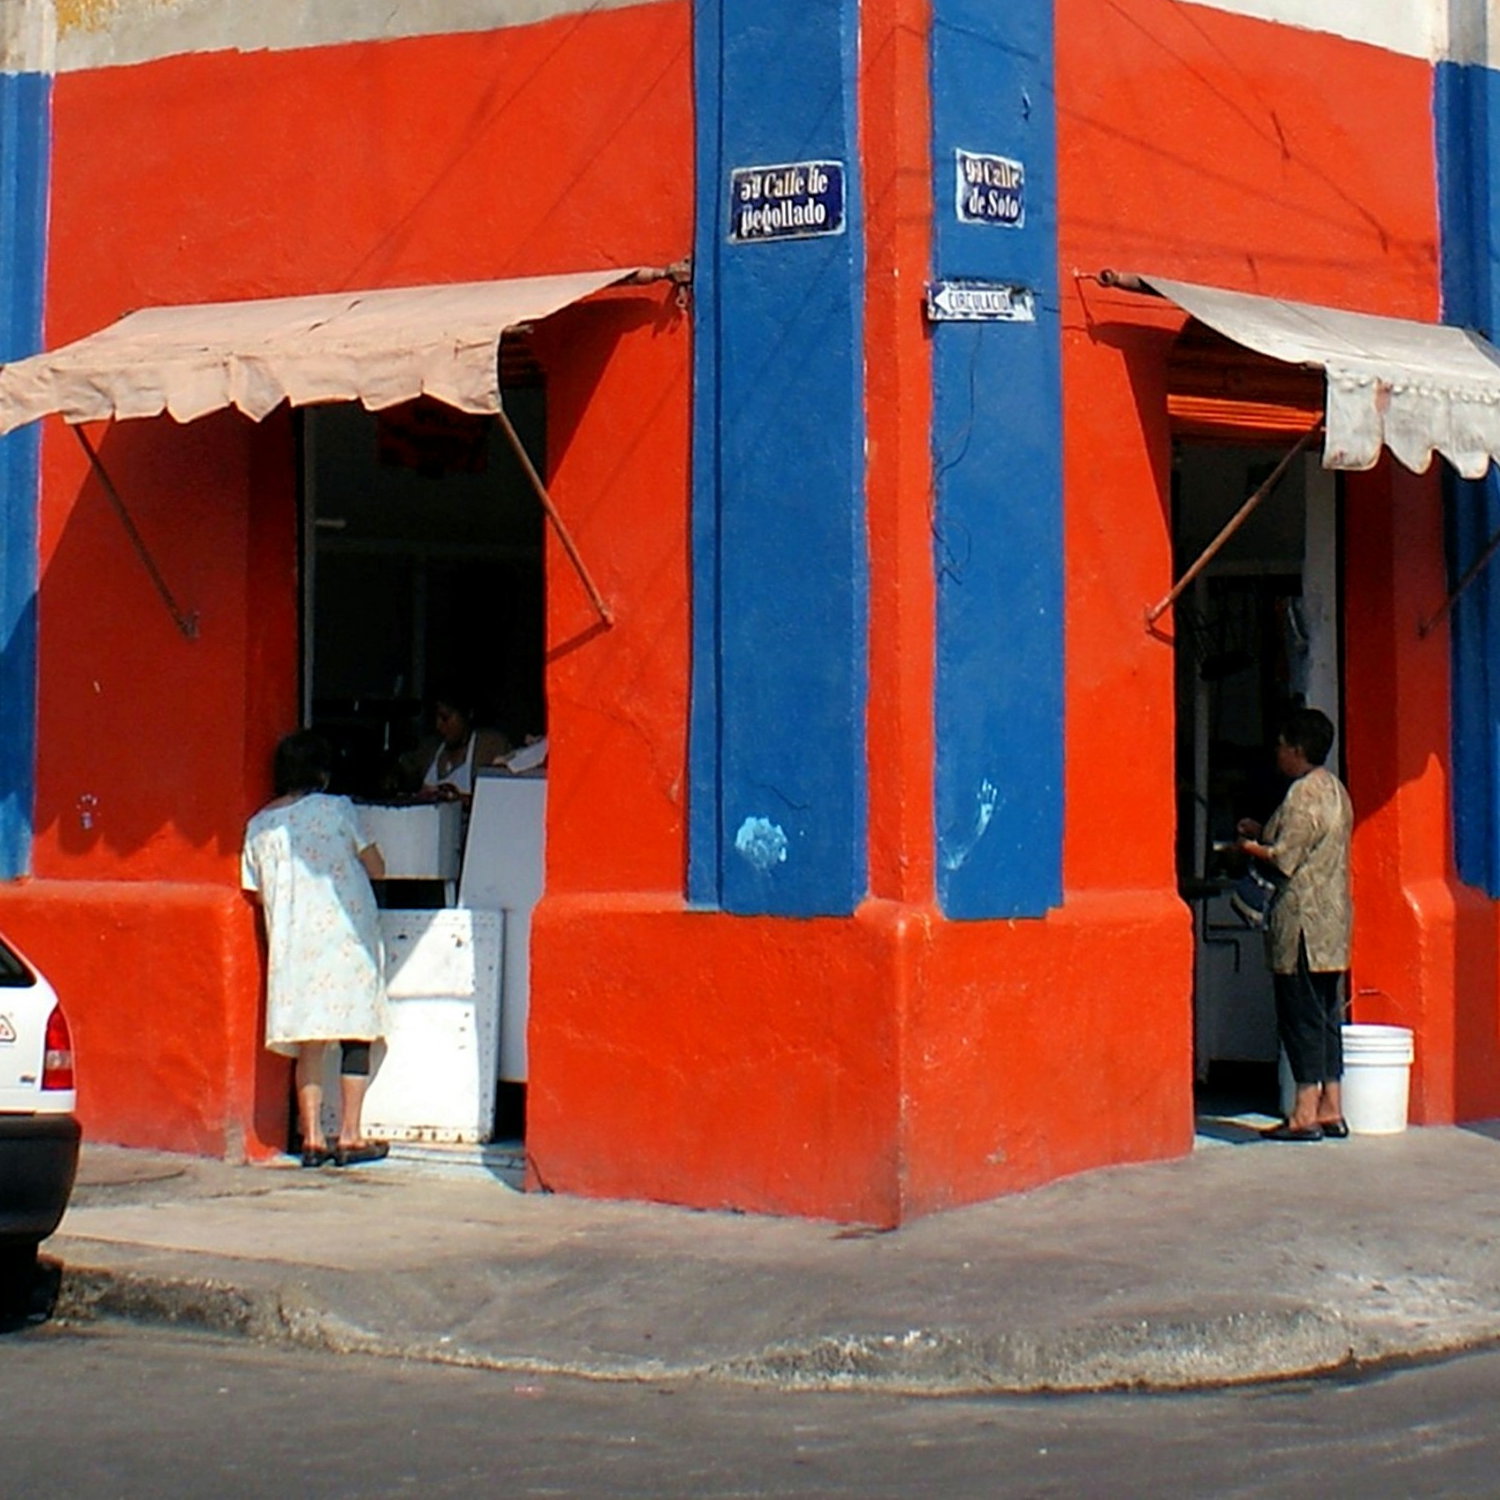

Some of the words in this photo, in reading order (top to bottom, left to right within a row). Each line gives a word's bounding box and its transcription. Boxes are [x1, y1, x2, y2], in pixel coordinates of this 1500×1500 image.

[763, 171, 805, 199] Calle
[807, 165, 829, 195] de
[983, 161, 1021, 190] Calle
[968, 185, 987, 215] de
[987, 188, 1020, 219] Soto
